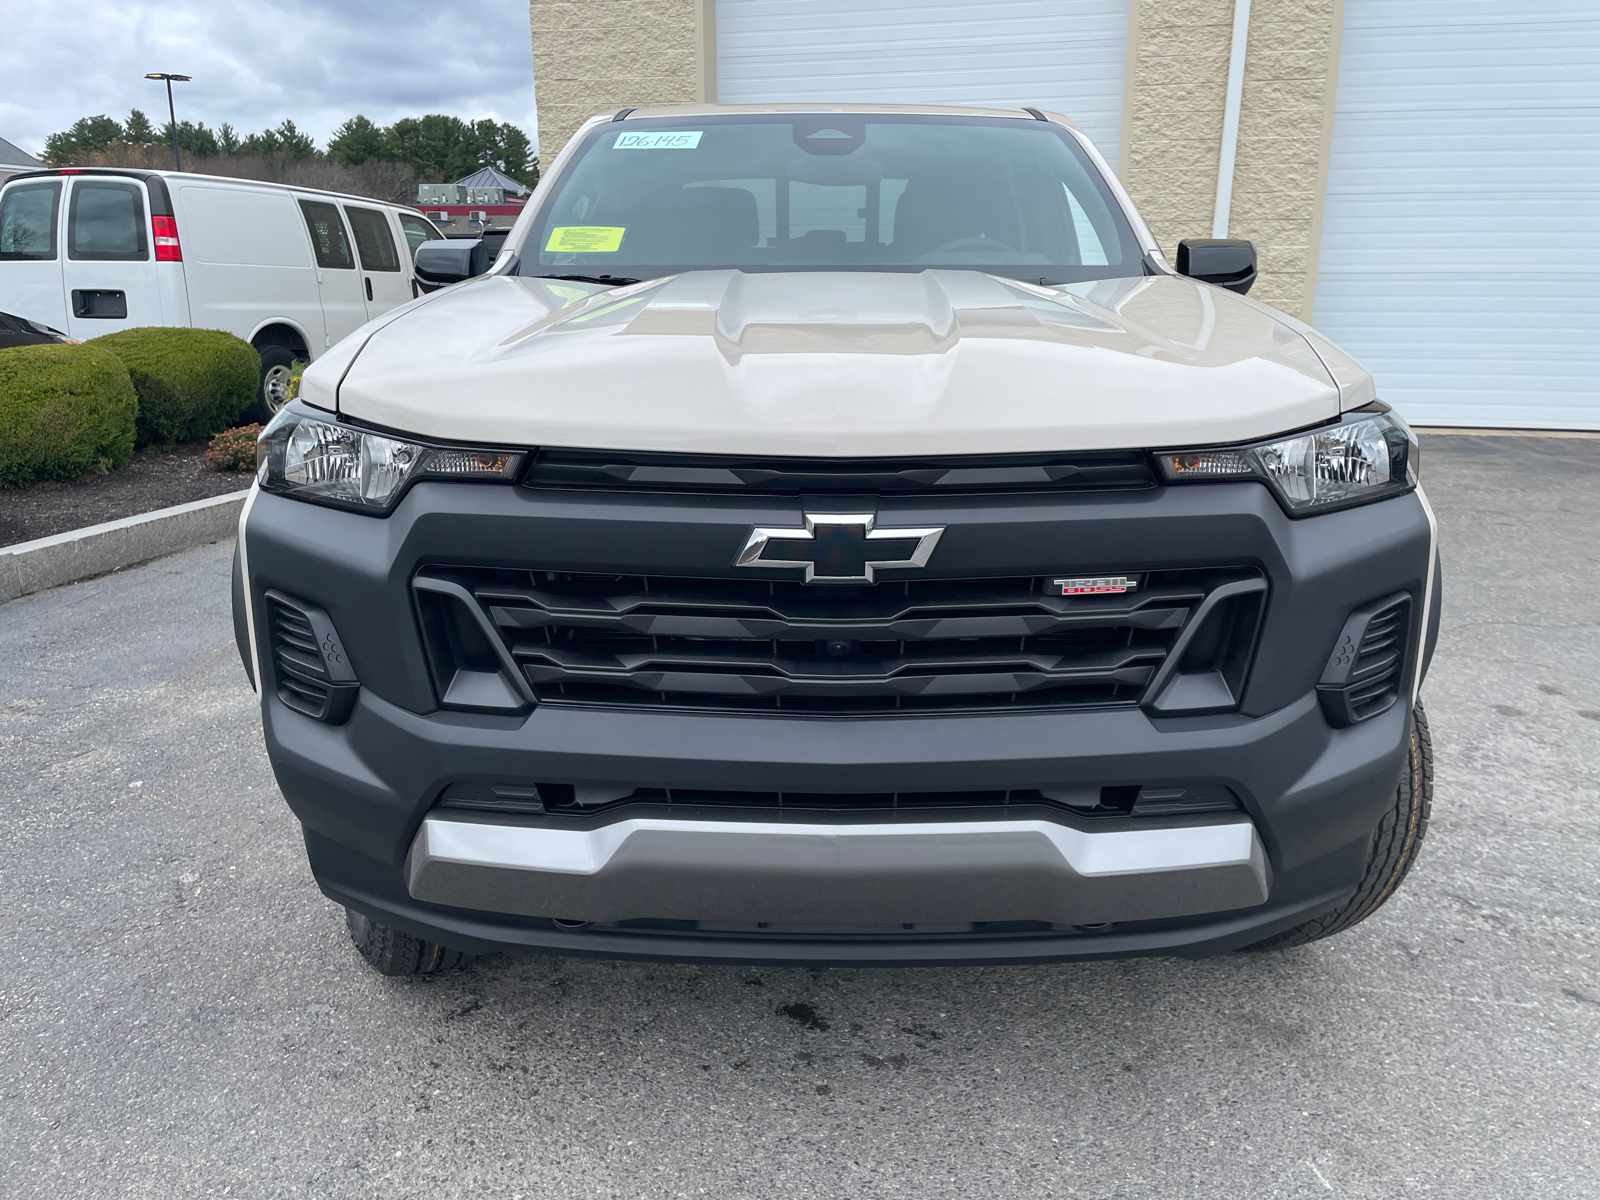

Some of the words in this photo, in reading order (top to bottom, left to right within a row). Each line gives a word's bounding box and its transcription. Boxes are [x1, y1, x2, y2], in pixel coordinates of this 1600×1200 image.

[618, 135, 692, 147] 126-145
[1053, 577, 1137, 588] TRAIL
[1062, 585, 1127, 595] BOSS
